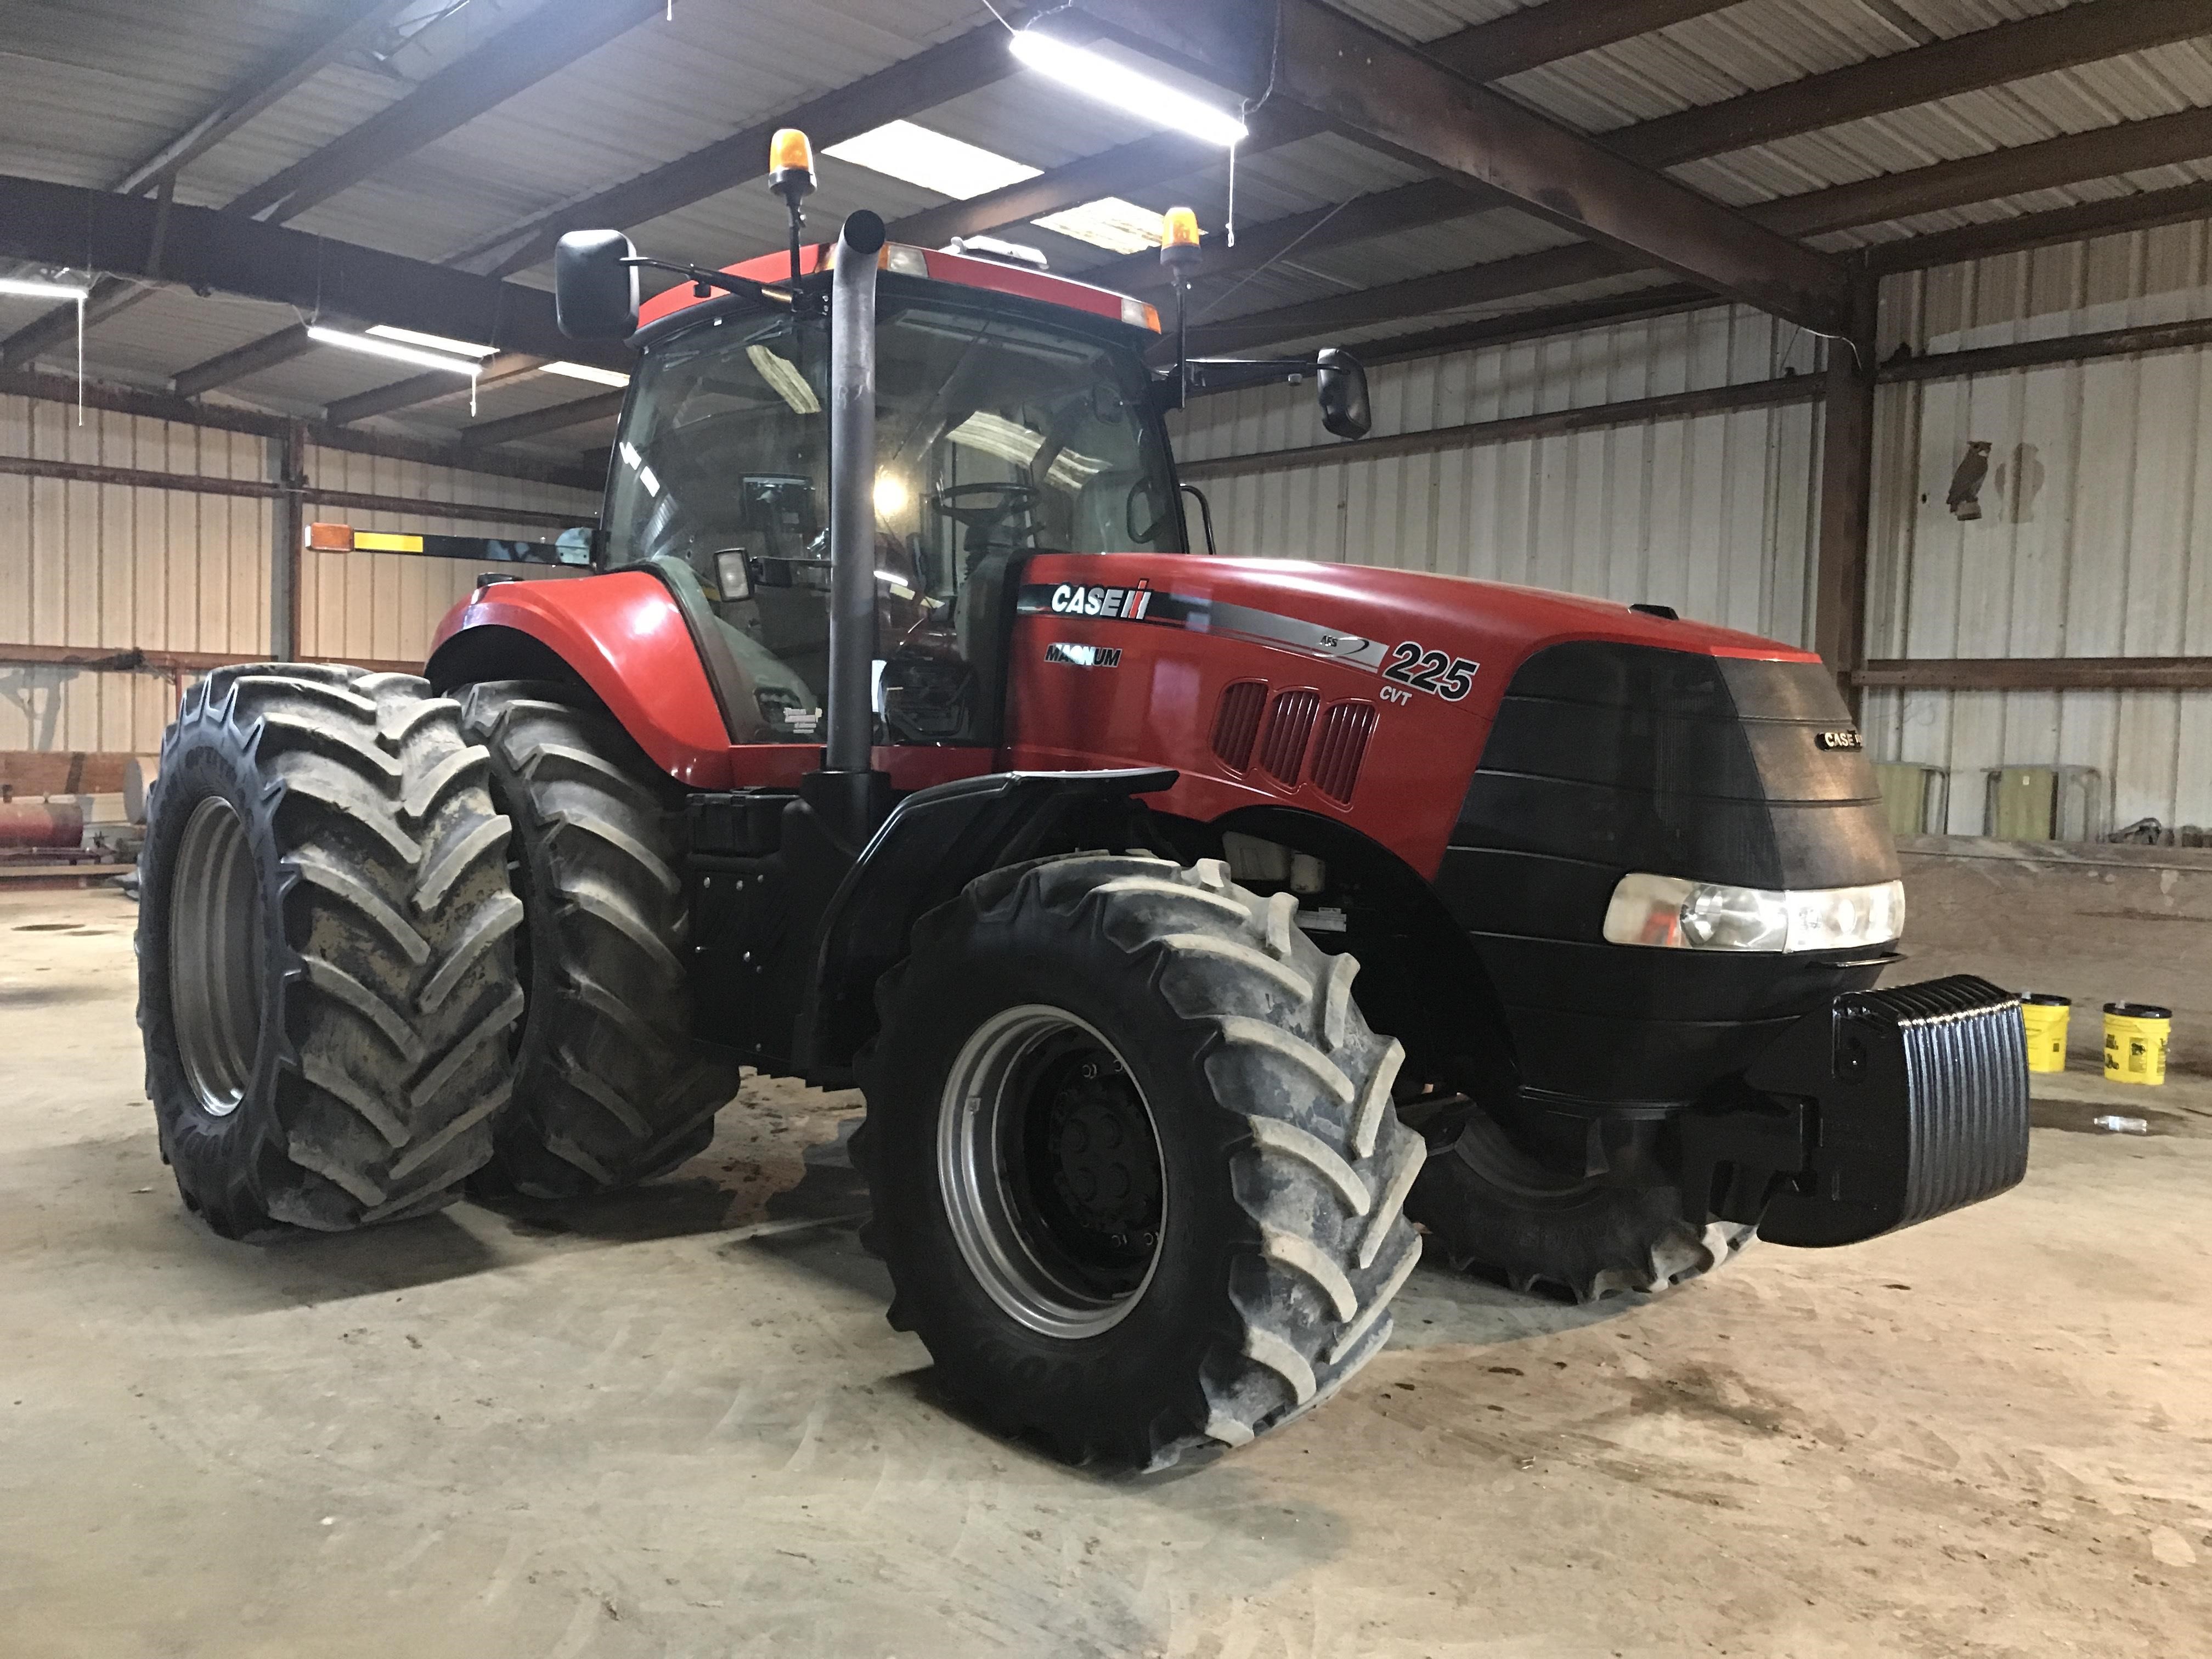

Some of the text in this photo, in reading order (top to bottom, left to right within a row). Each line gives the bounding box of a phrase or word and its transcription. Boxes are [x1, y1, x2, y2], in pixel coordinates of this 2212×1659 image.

[1052, 584, 1124, 617] CASE
[1382, 641, 1480, 702] 225
[1380, 685, 1413, 706] CVT
[1825, 732, 1855, 747] CASE
